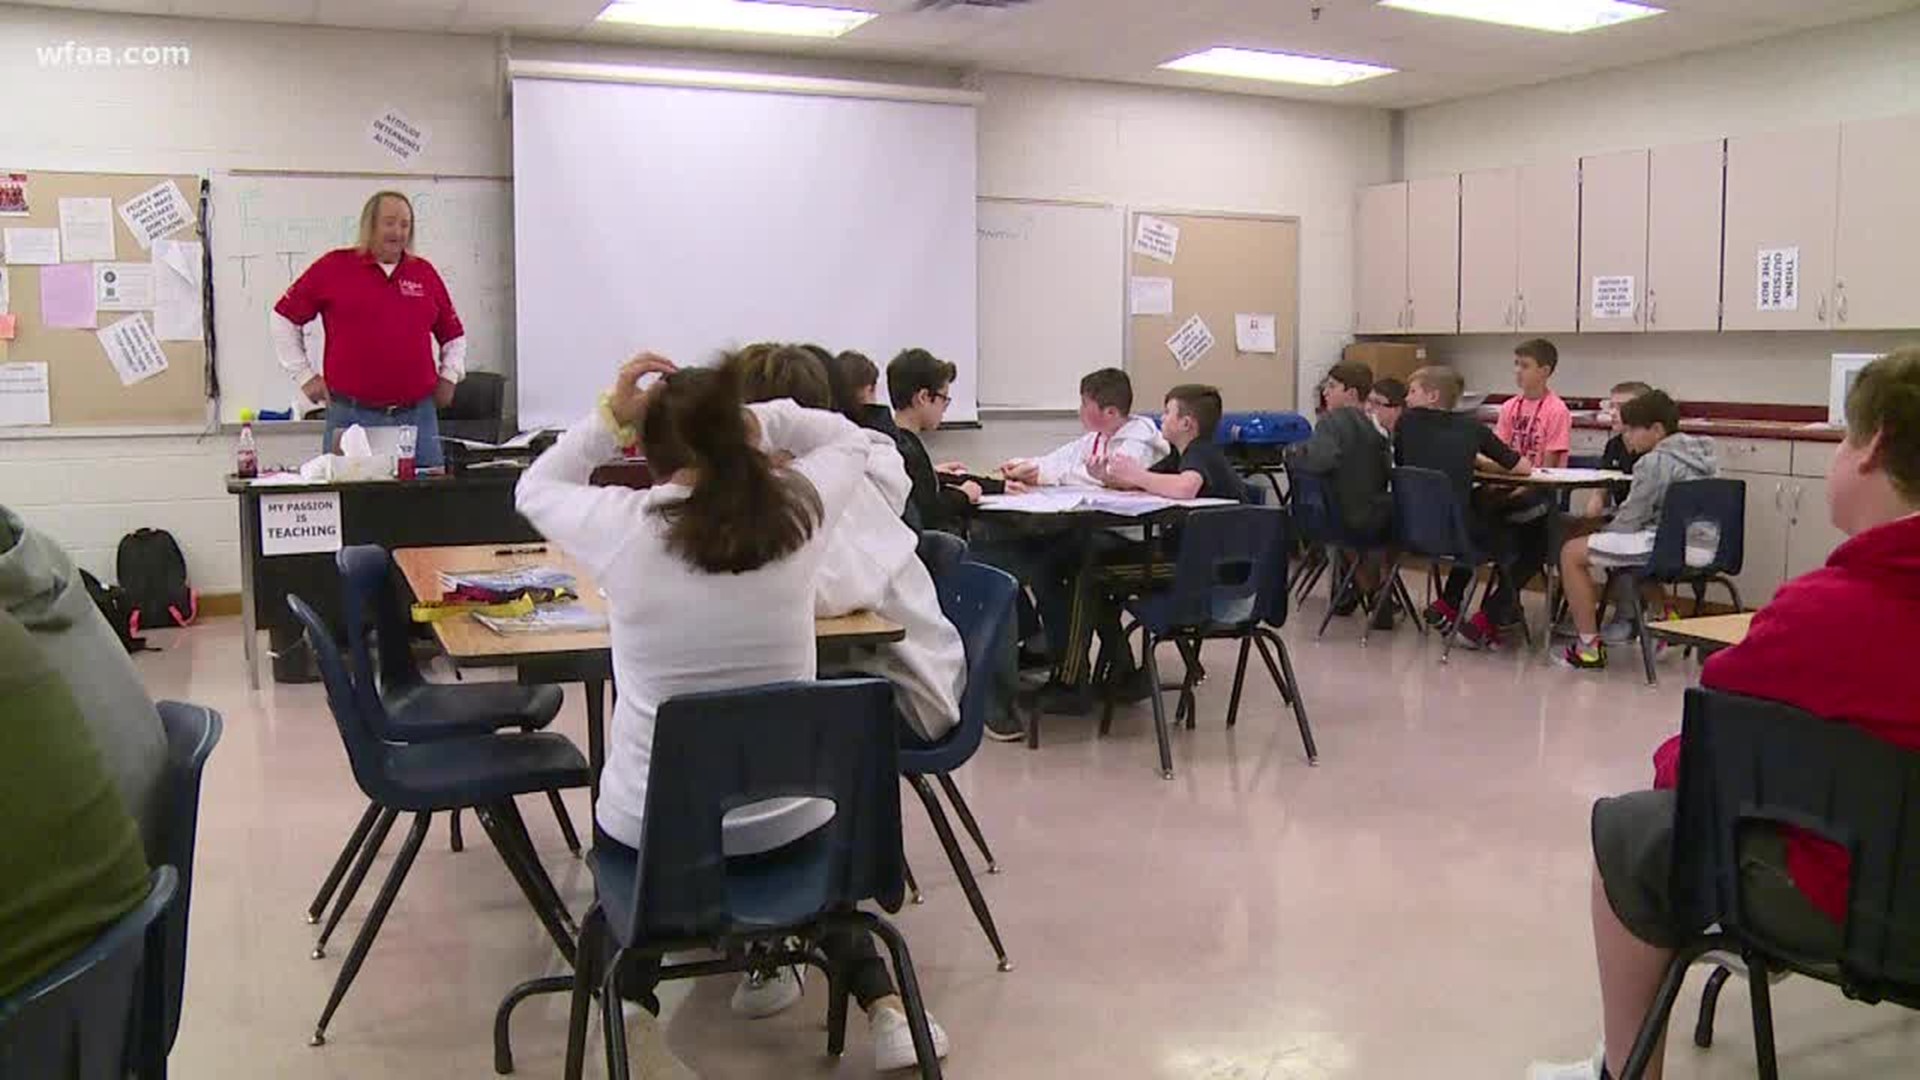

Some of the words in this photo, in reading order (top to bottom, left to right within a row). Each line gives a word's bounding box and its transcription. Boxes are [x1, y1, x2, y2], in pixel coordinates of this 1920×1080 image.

[126, 197, 150, 213] PEOPLE
[1761, 256, 1770, 276] THE
[1773, 253, 1782, 305] OUTSIDE
[1785, 259, 1793, 299] THINK
[1761, 281, 1769, 305] BOX
[268, 504, 284, 512] MY
[287, 501, 333, 511] PASSION
[296, 514, 307, 522] IS
[267, 526, 336, 539] TEACHING
